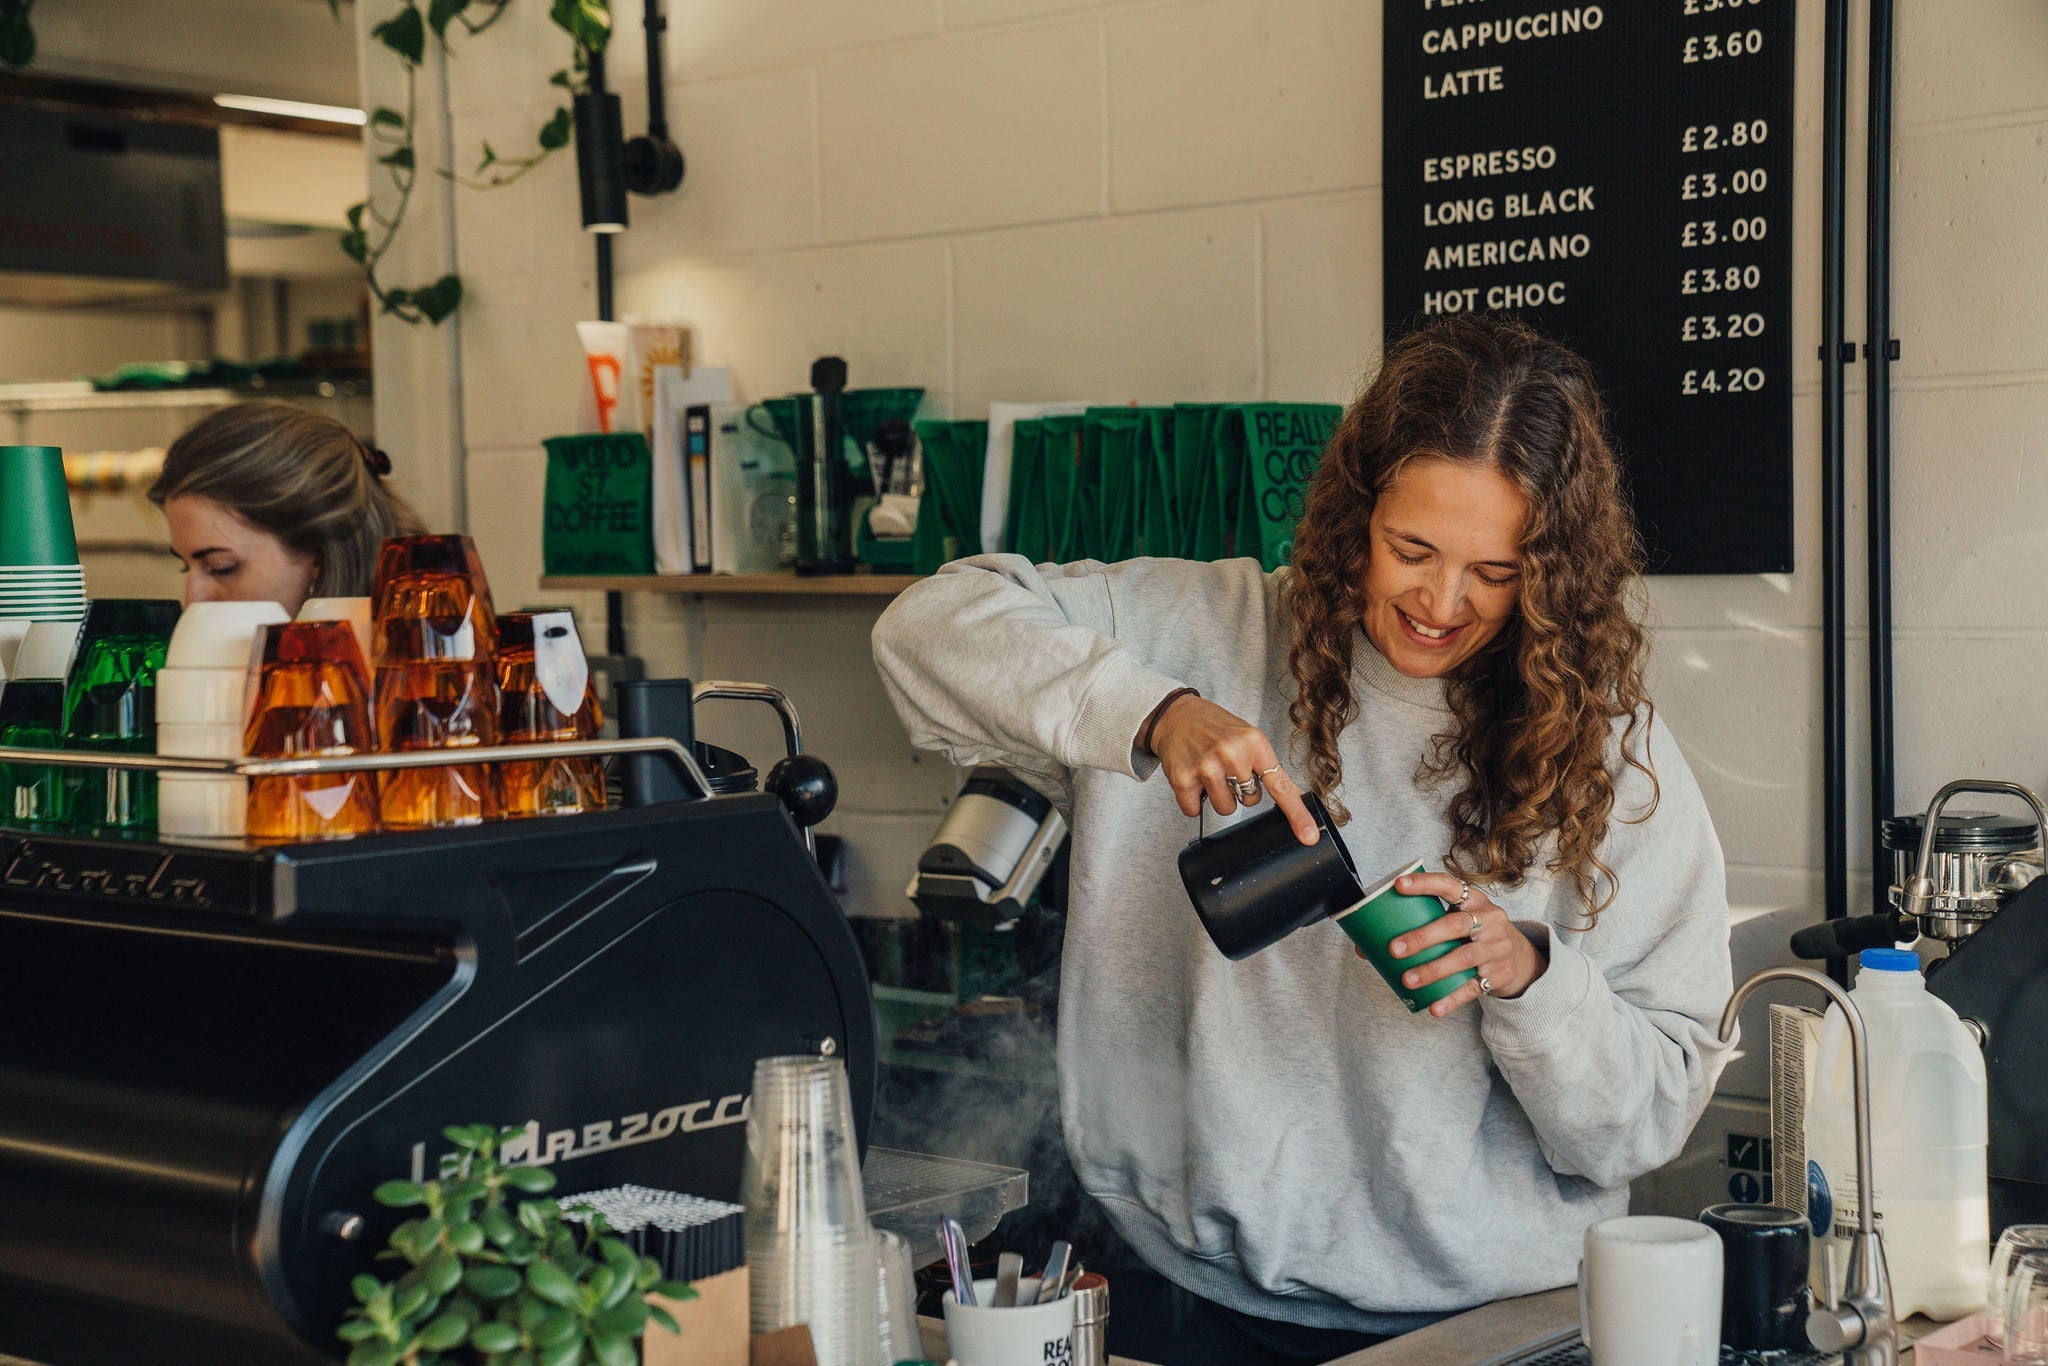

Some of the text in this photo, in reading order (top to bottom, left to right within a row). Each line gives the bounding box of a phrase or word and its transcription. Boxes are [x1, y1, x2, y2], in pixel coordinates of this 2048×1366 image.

[1422, 5, 1604, 54] CAPPUCCINO
[1682, 29, 1763, 64] £3.60
[1424, 65, 1504, 100] LATTE
[1681, 119, 1768, 153] £2.80
[1424, 145, 1557, 183] ESPRESSO
[1681, 168, 1767, 200] £3.00
[1424, 186, 1595, 227] LONG BLACK
[1681, 216, 1767, 248] £3.00
[1424, 233, 1590, 271] AMERICANO
[1681, 265, 1761, 295] £3.80
[1424, 281, 1566, 315] HOT CHOC
[1681, 313, 1765, 342] £3.20
[1681, 367, 1765, 395] £4.20
[548, 500, 640, 533] COFFEE
